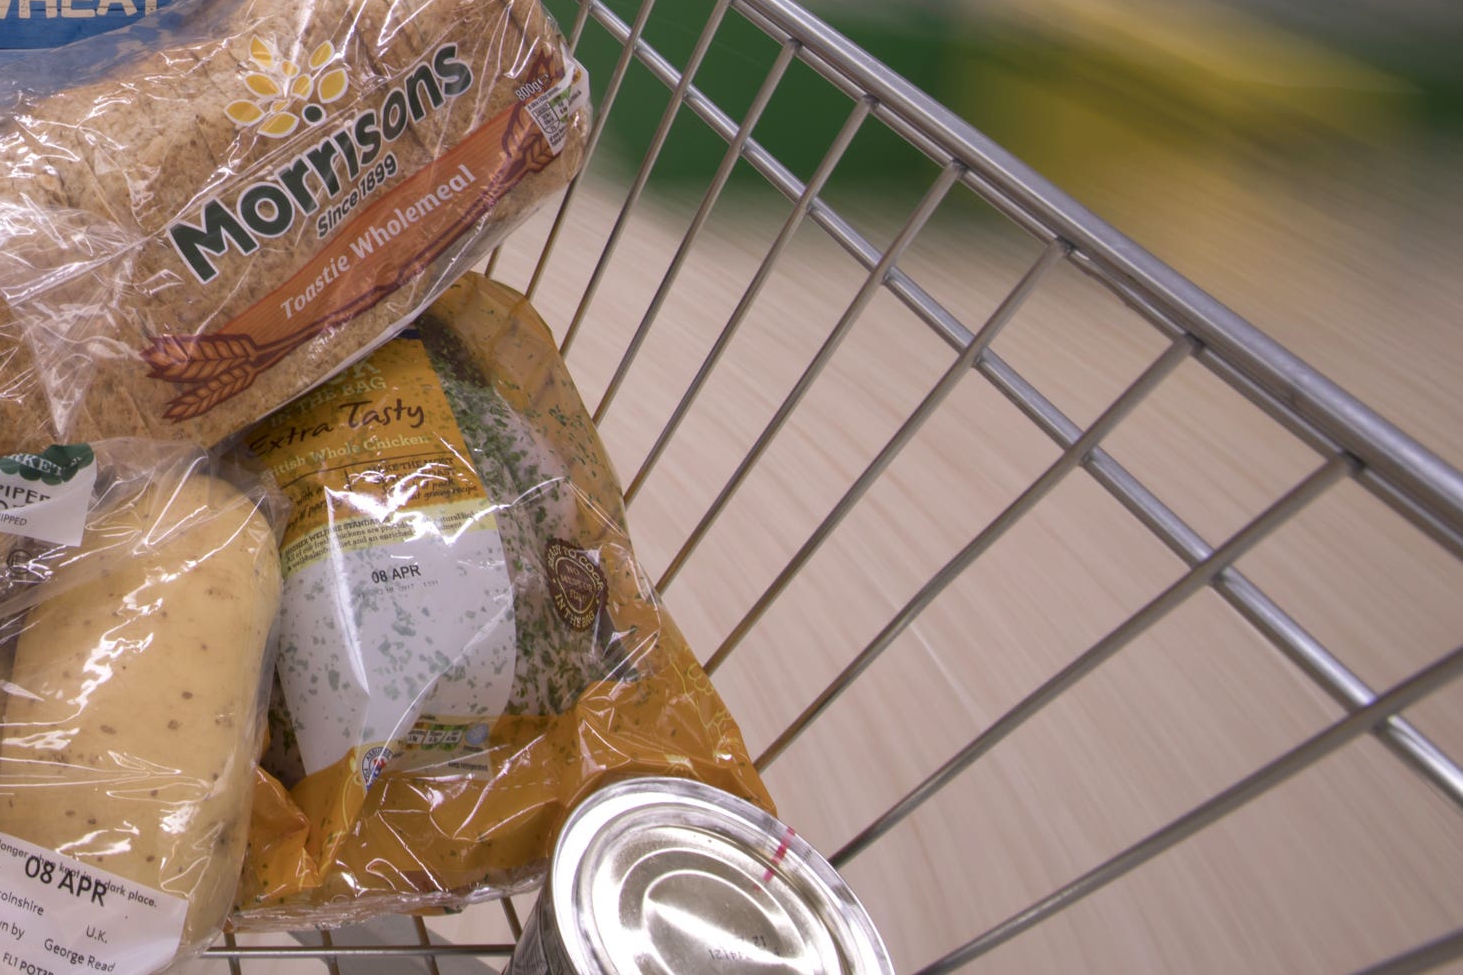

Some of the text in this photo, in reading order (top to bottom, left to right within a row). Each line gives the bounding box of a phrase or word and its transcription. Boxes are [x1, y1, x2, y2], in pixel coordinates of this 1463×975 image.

[166, 42, 473, 285] Morrisons
[316, 151, 399, 240] Since 1899
[280, 164, 477, 320] Toastie Wholemeal
[341, 376, 387, 396] BAG
[249, 398, 425, 458] Extra Tasty
[309, 441, 360, 463] Whole
[362, 433, 430, 451] Chicken
[371, 564, 422, 584] 08 APR
[25, 856, 108, 907] 08 APR
[104, 880, 126, 896] dark
[128, 890, 158, 909] place.
[10, 926, 26, 940] by
[86, 925, 108, 944] U.K.
[44, 938, 116, 973] George Read
